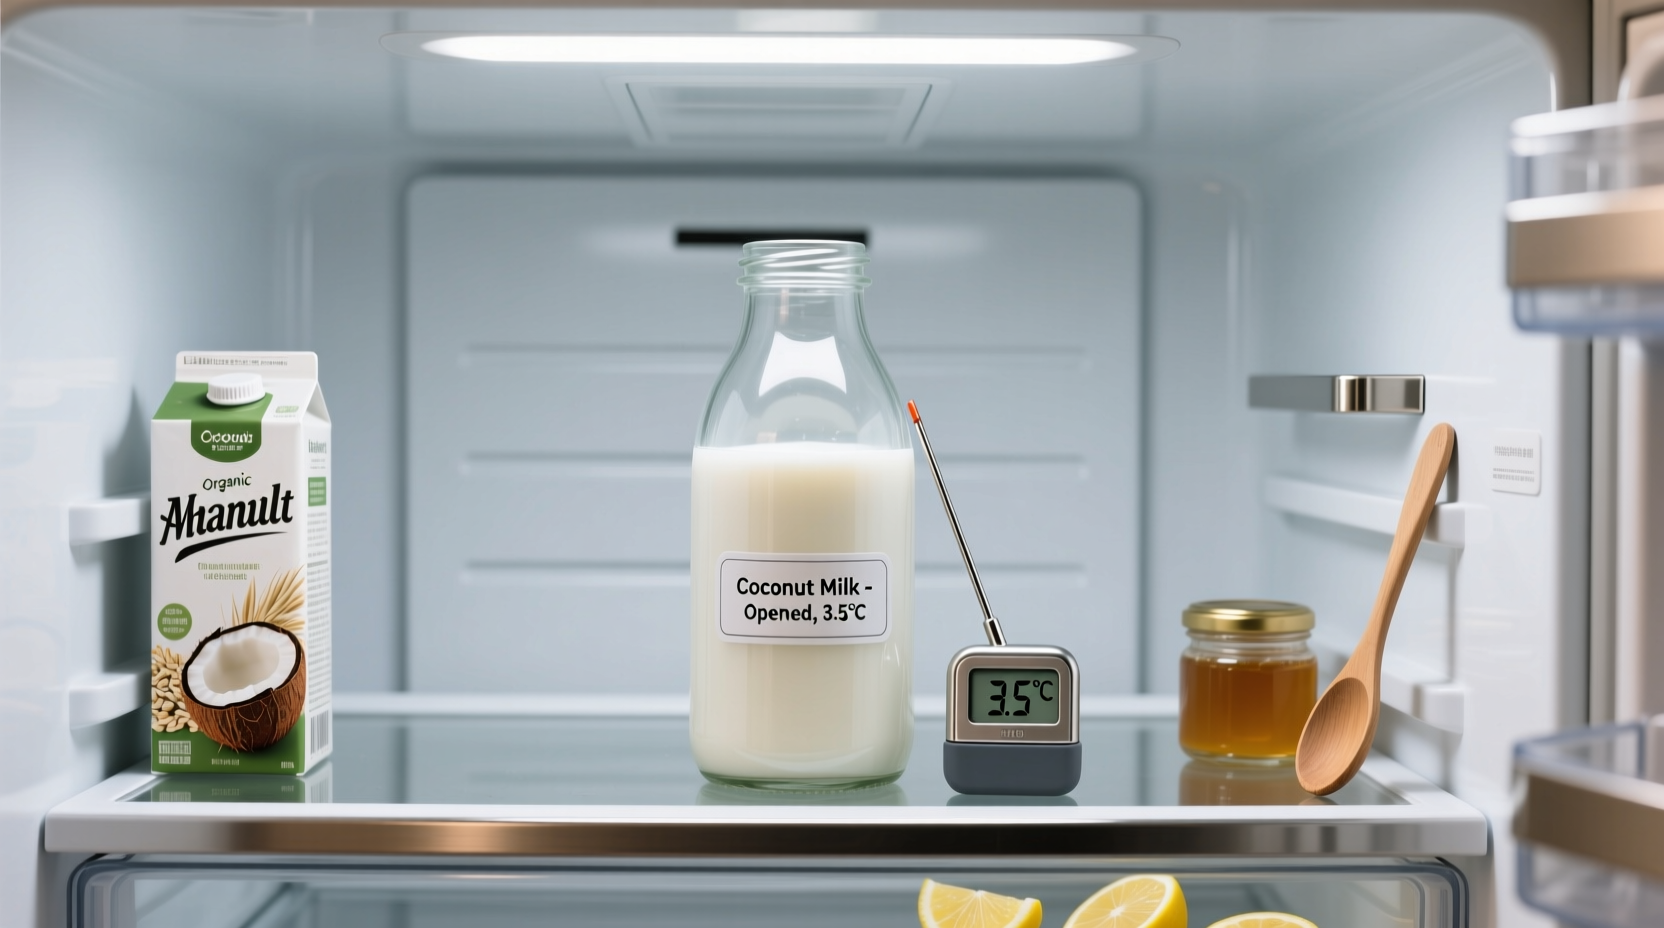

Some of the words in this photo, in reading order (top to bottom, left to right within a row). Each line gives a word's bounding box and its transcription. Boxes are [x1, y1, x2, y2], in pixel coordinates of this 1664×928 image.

[202, 472, 252, 492] Organic
[737, 577, 815, 596] Coconut
[820, 577, 860, 596] Milk
[744, 603, 818, 625] Opened,
[823, 603, 866, 621] 3.5°C
[988, 680, 1053, 716] 3.5°C
